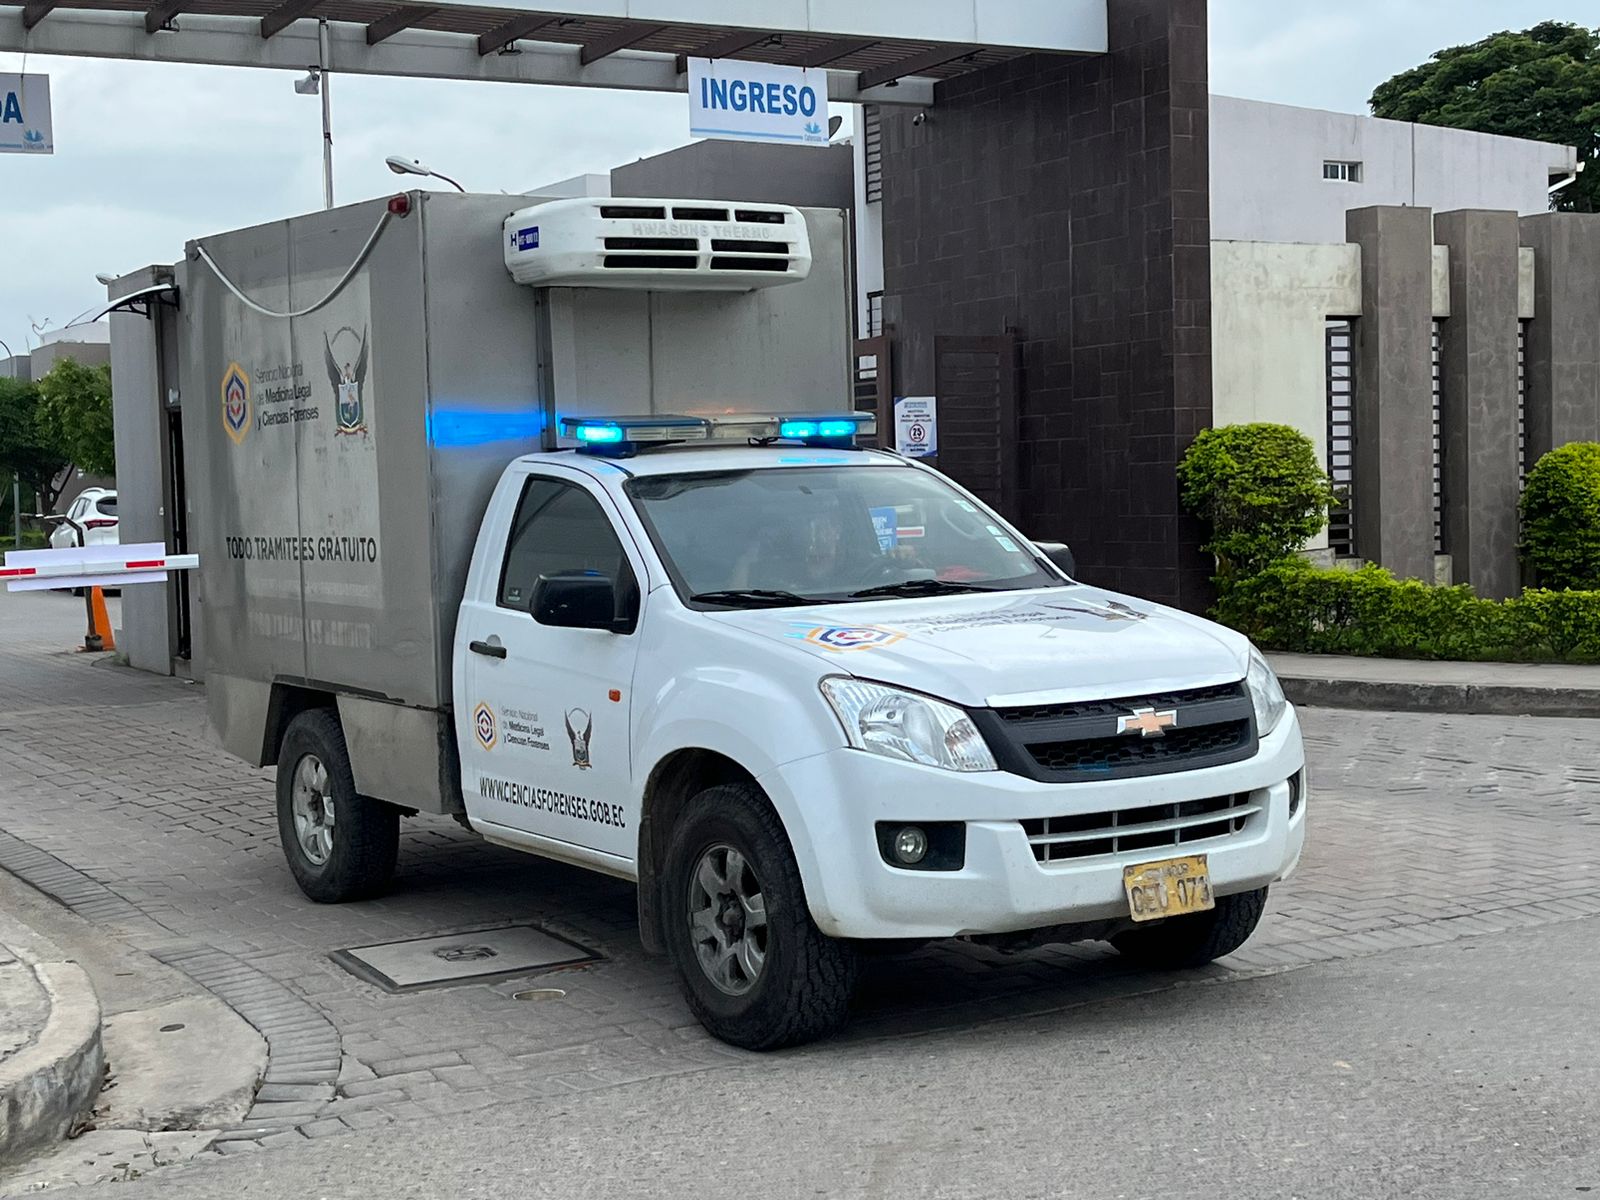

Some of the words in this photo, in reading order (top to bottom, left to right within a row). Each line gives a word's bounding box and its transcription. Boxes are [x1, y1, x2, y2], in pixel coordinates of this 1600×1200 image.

[0, 91, 24, 124] A
[701, 77, 816, 117] INGRESO
[294, 381, 312, 403] Legal
[262, 408, 289, 426] Ciencias
[290, 406, 319, 422] Forenses
[912, 427, 922, 437] 25
[254, 537, 299, 560] TRAMITE
[302, 537, 315, 560] ES
[318, 537, 377, 562] GRATUITO
[480, 777, 626, 828] WWW.CIENCIASFORENSES.GOB.EC
